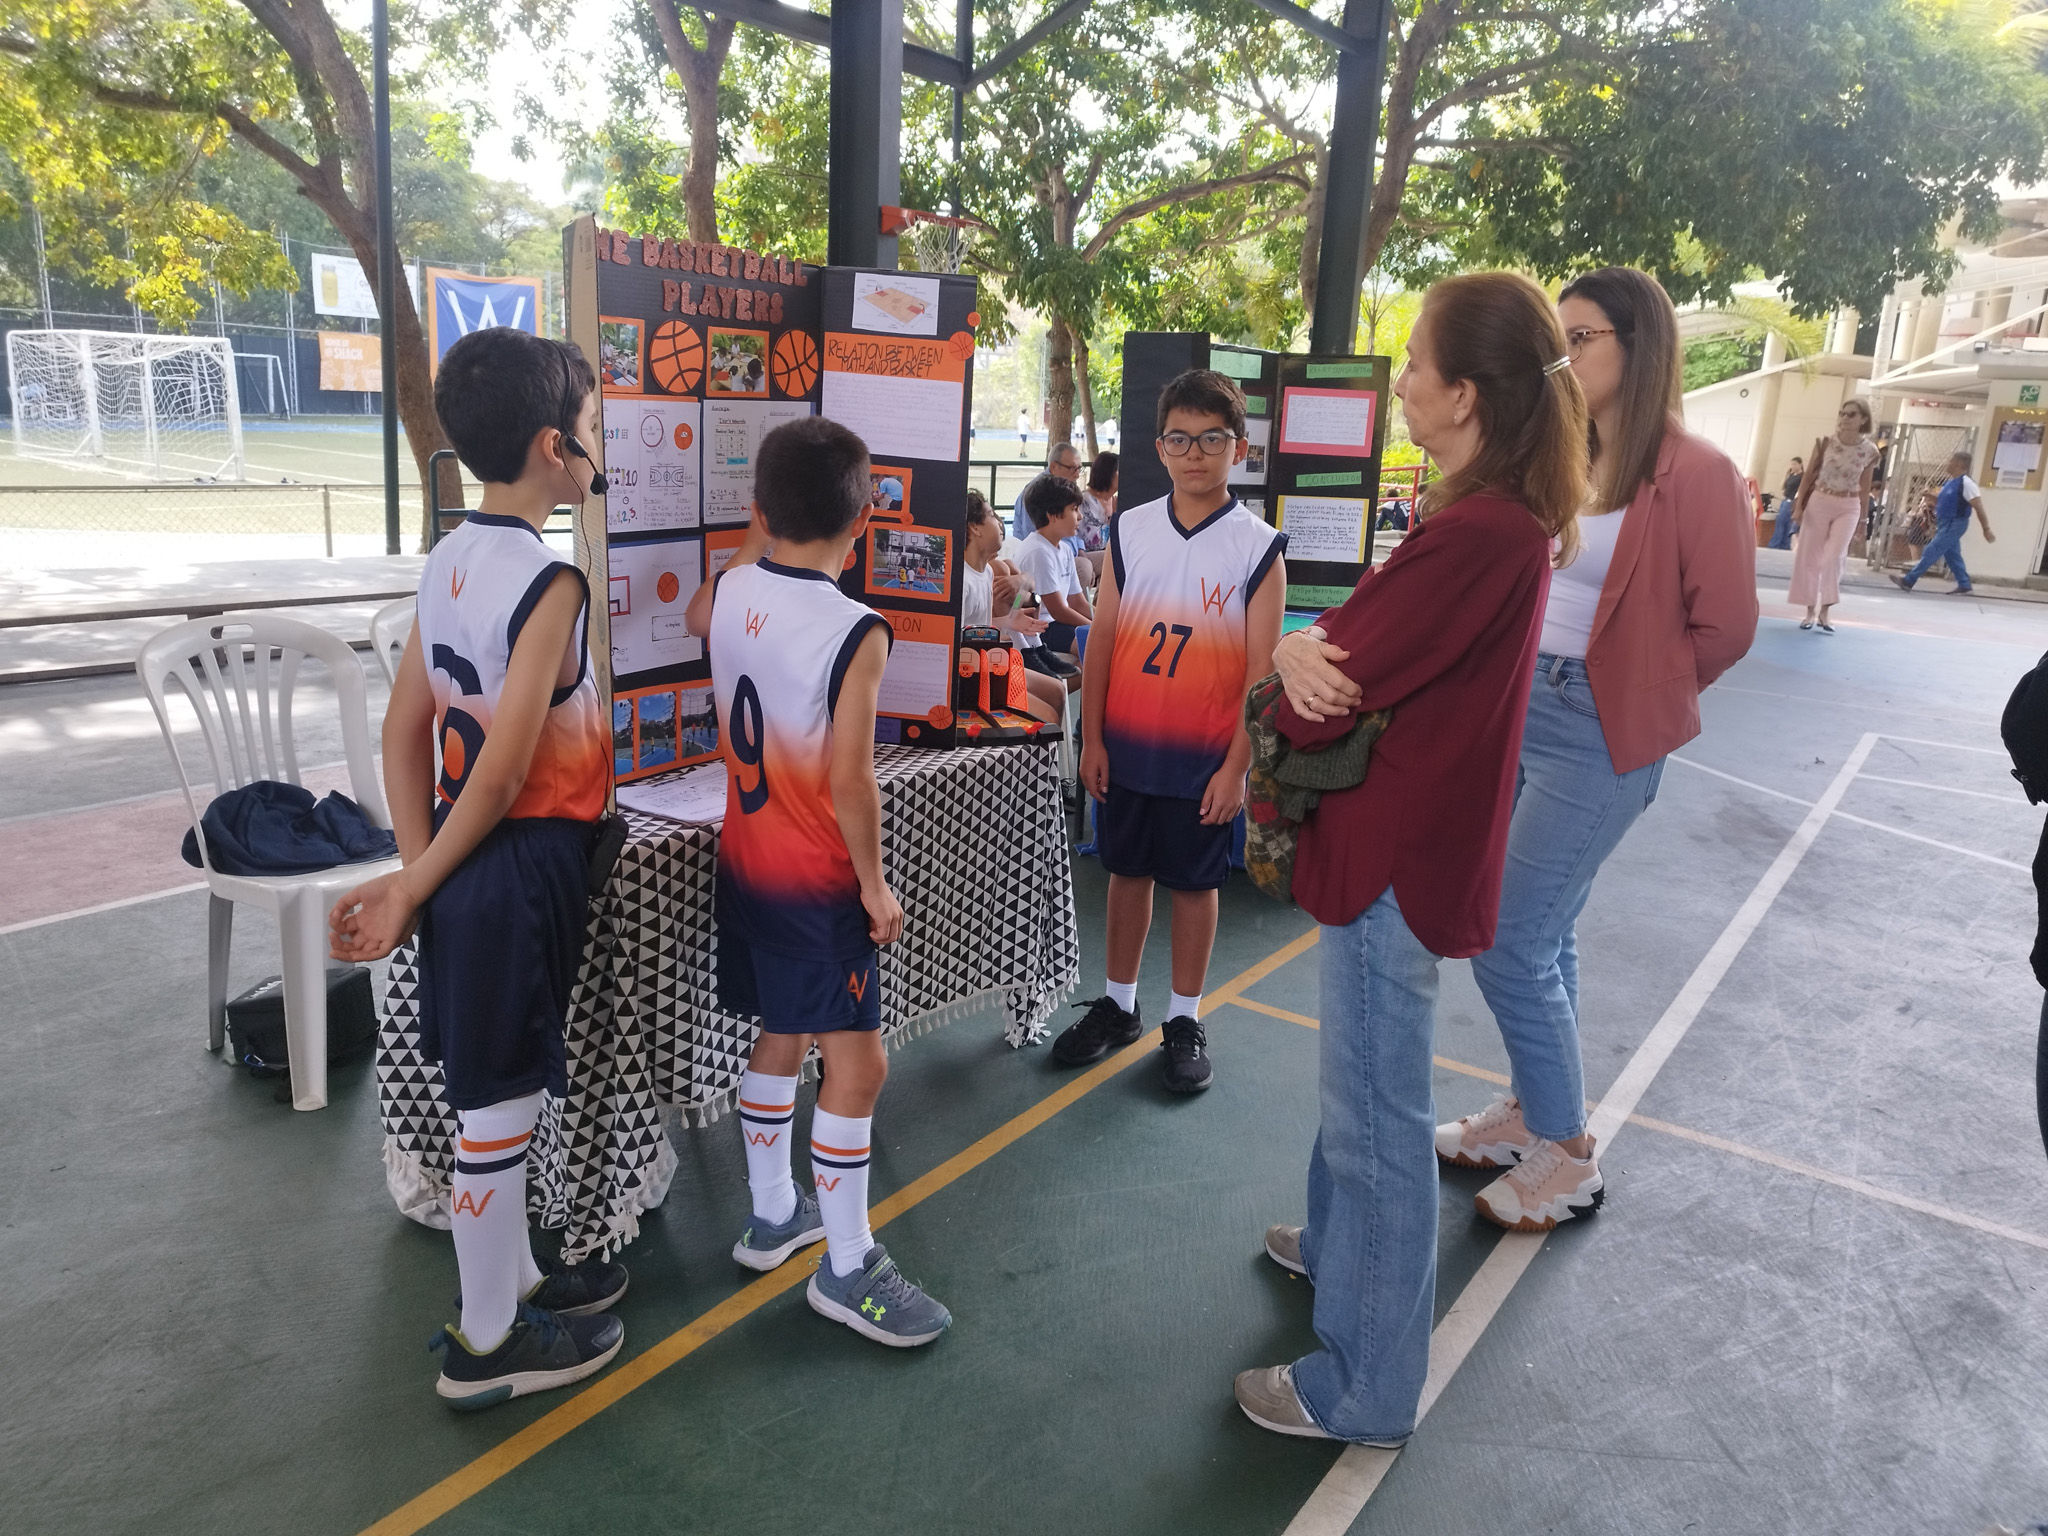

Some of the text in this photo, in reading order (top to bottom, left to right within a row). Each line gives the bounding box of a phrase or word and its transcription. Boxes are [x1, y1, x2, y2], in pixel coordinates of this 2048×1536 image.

[596, 227, 632, 265] HE
[642, 233, 808, 287] BASKETBALL
[662, 278, 783, 324] PLAYERS
[828, 338, 943, 364] RELATION BETWEEN
[865, 359, 889, 375] AND
[889, 359, 933, 378] BASKET
[1306, 474, 1361, 485] CONCLUSION
[884, 615, 922, 633] ION
[1142, 621, 1193, 678] 27
[729, 674, 769, 815] 9
